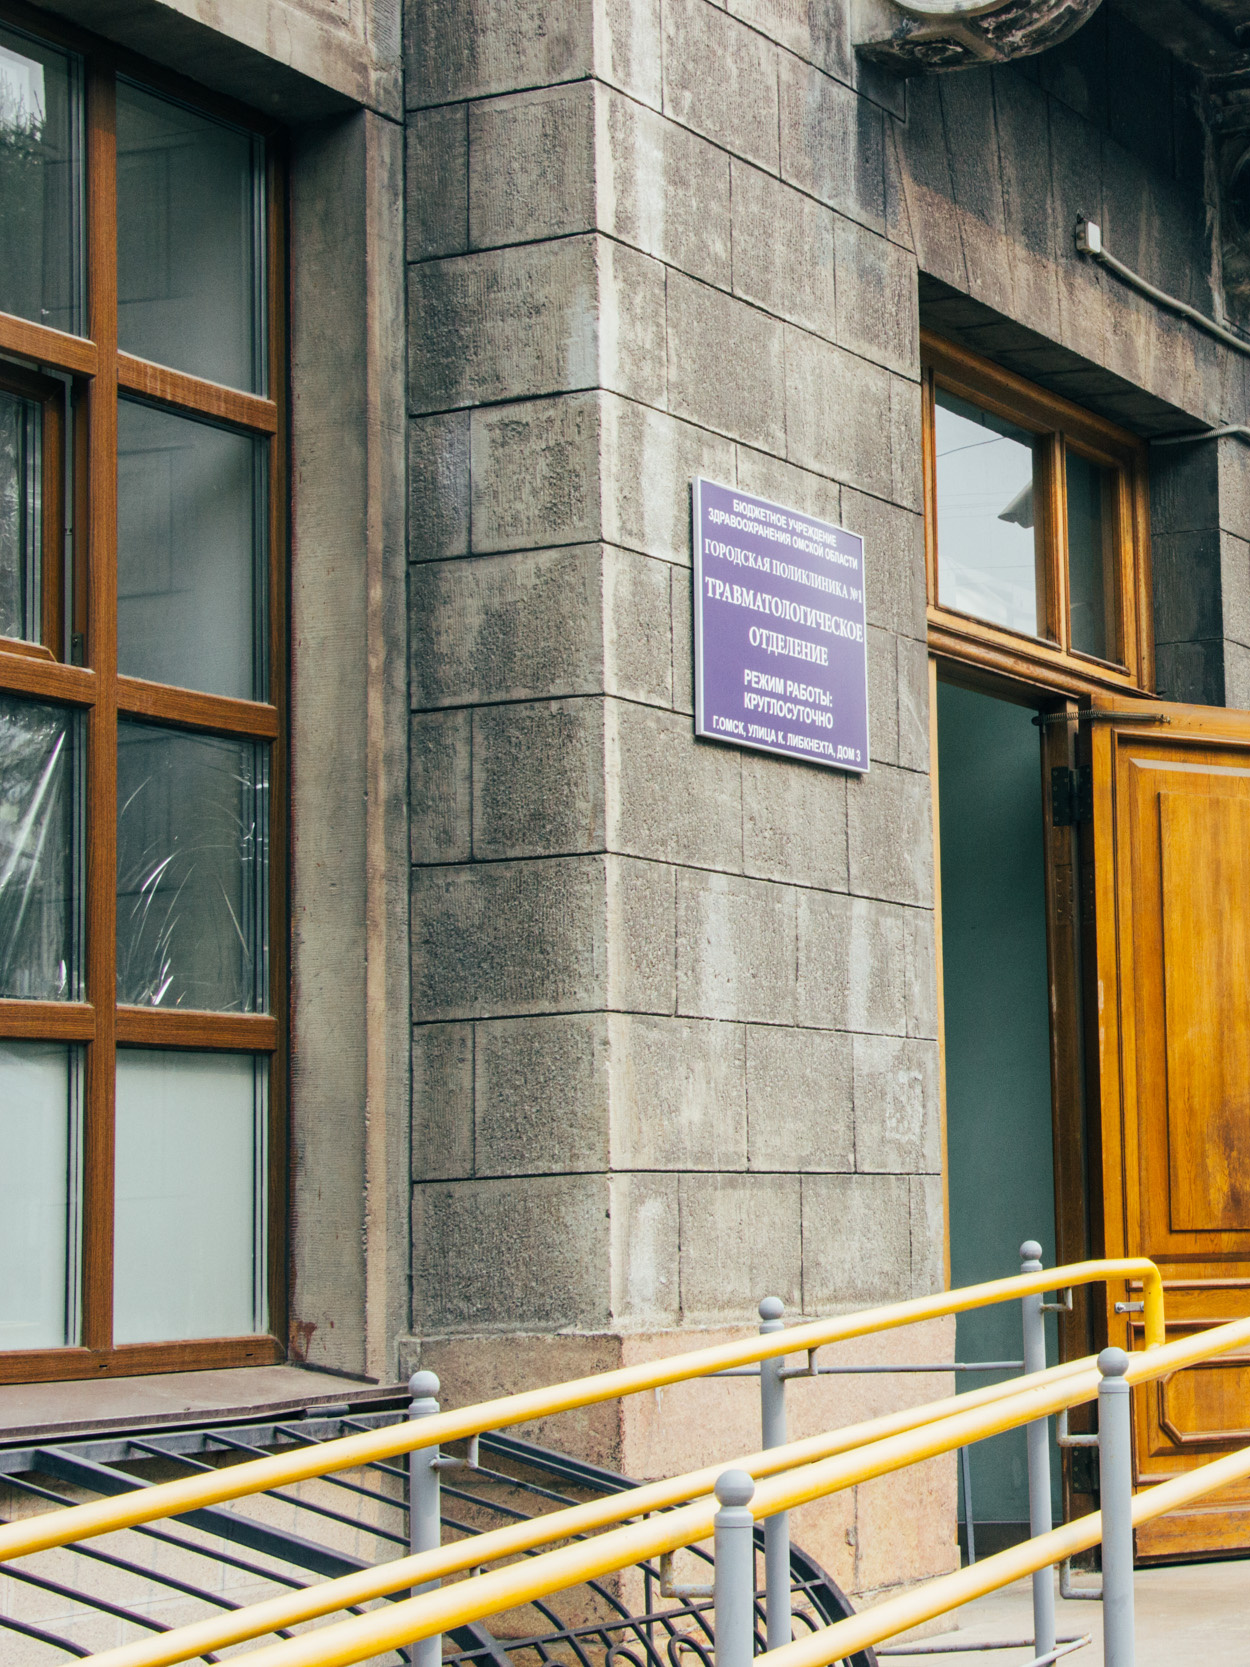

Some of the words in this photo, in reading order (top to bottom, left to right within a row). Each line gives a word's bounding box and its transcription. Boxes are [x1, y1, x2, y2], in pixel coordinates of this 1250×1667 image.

[708, 508, 791, 545] ЗДРАВООХРАНЕНИЯ
[793, 536, 824, 557] ОМСКОЙ
[825, 548, 858, 570] ОБЛАСТИ
[733, 499, 787, 528] БЮДЖЕТНОЕ
[789, 518, 837, 547] УЧРЕЖДЕНИЕ
[705, 538, 770, 572] ГОРОДСКАЯ
[772, 560, 848, 598] ПОЛИКЛИНИКА
[850, 586, 862, 603] №1
[705, 576, 863, 642] ТРАВМАТОЛОГИЧЕСКОЕ
[749, 626, 828, 666] ОТДЕЛЕНИЕ
[744, 669, 784, 694] РЕЖИМ
[787, 680, 832, 707] РАБОТЫ:
[744, 692, 833, 728] КРУГЛОСУТОЧНО
[713, 716, 746, 737] Г.ОМСК,
[748, 724, 776, 743] УЛИЦА
[778, 731, 785, 744] К.
[787, 733, 835, 758] ЛИБКНЕХТА,
[837, 745, 854, 760] ДОМ
[856, 750, 861, 761] 3
